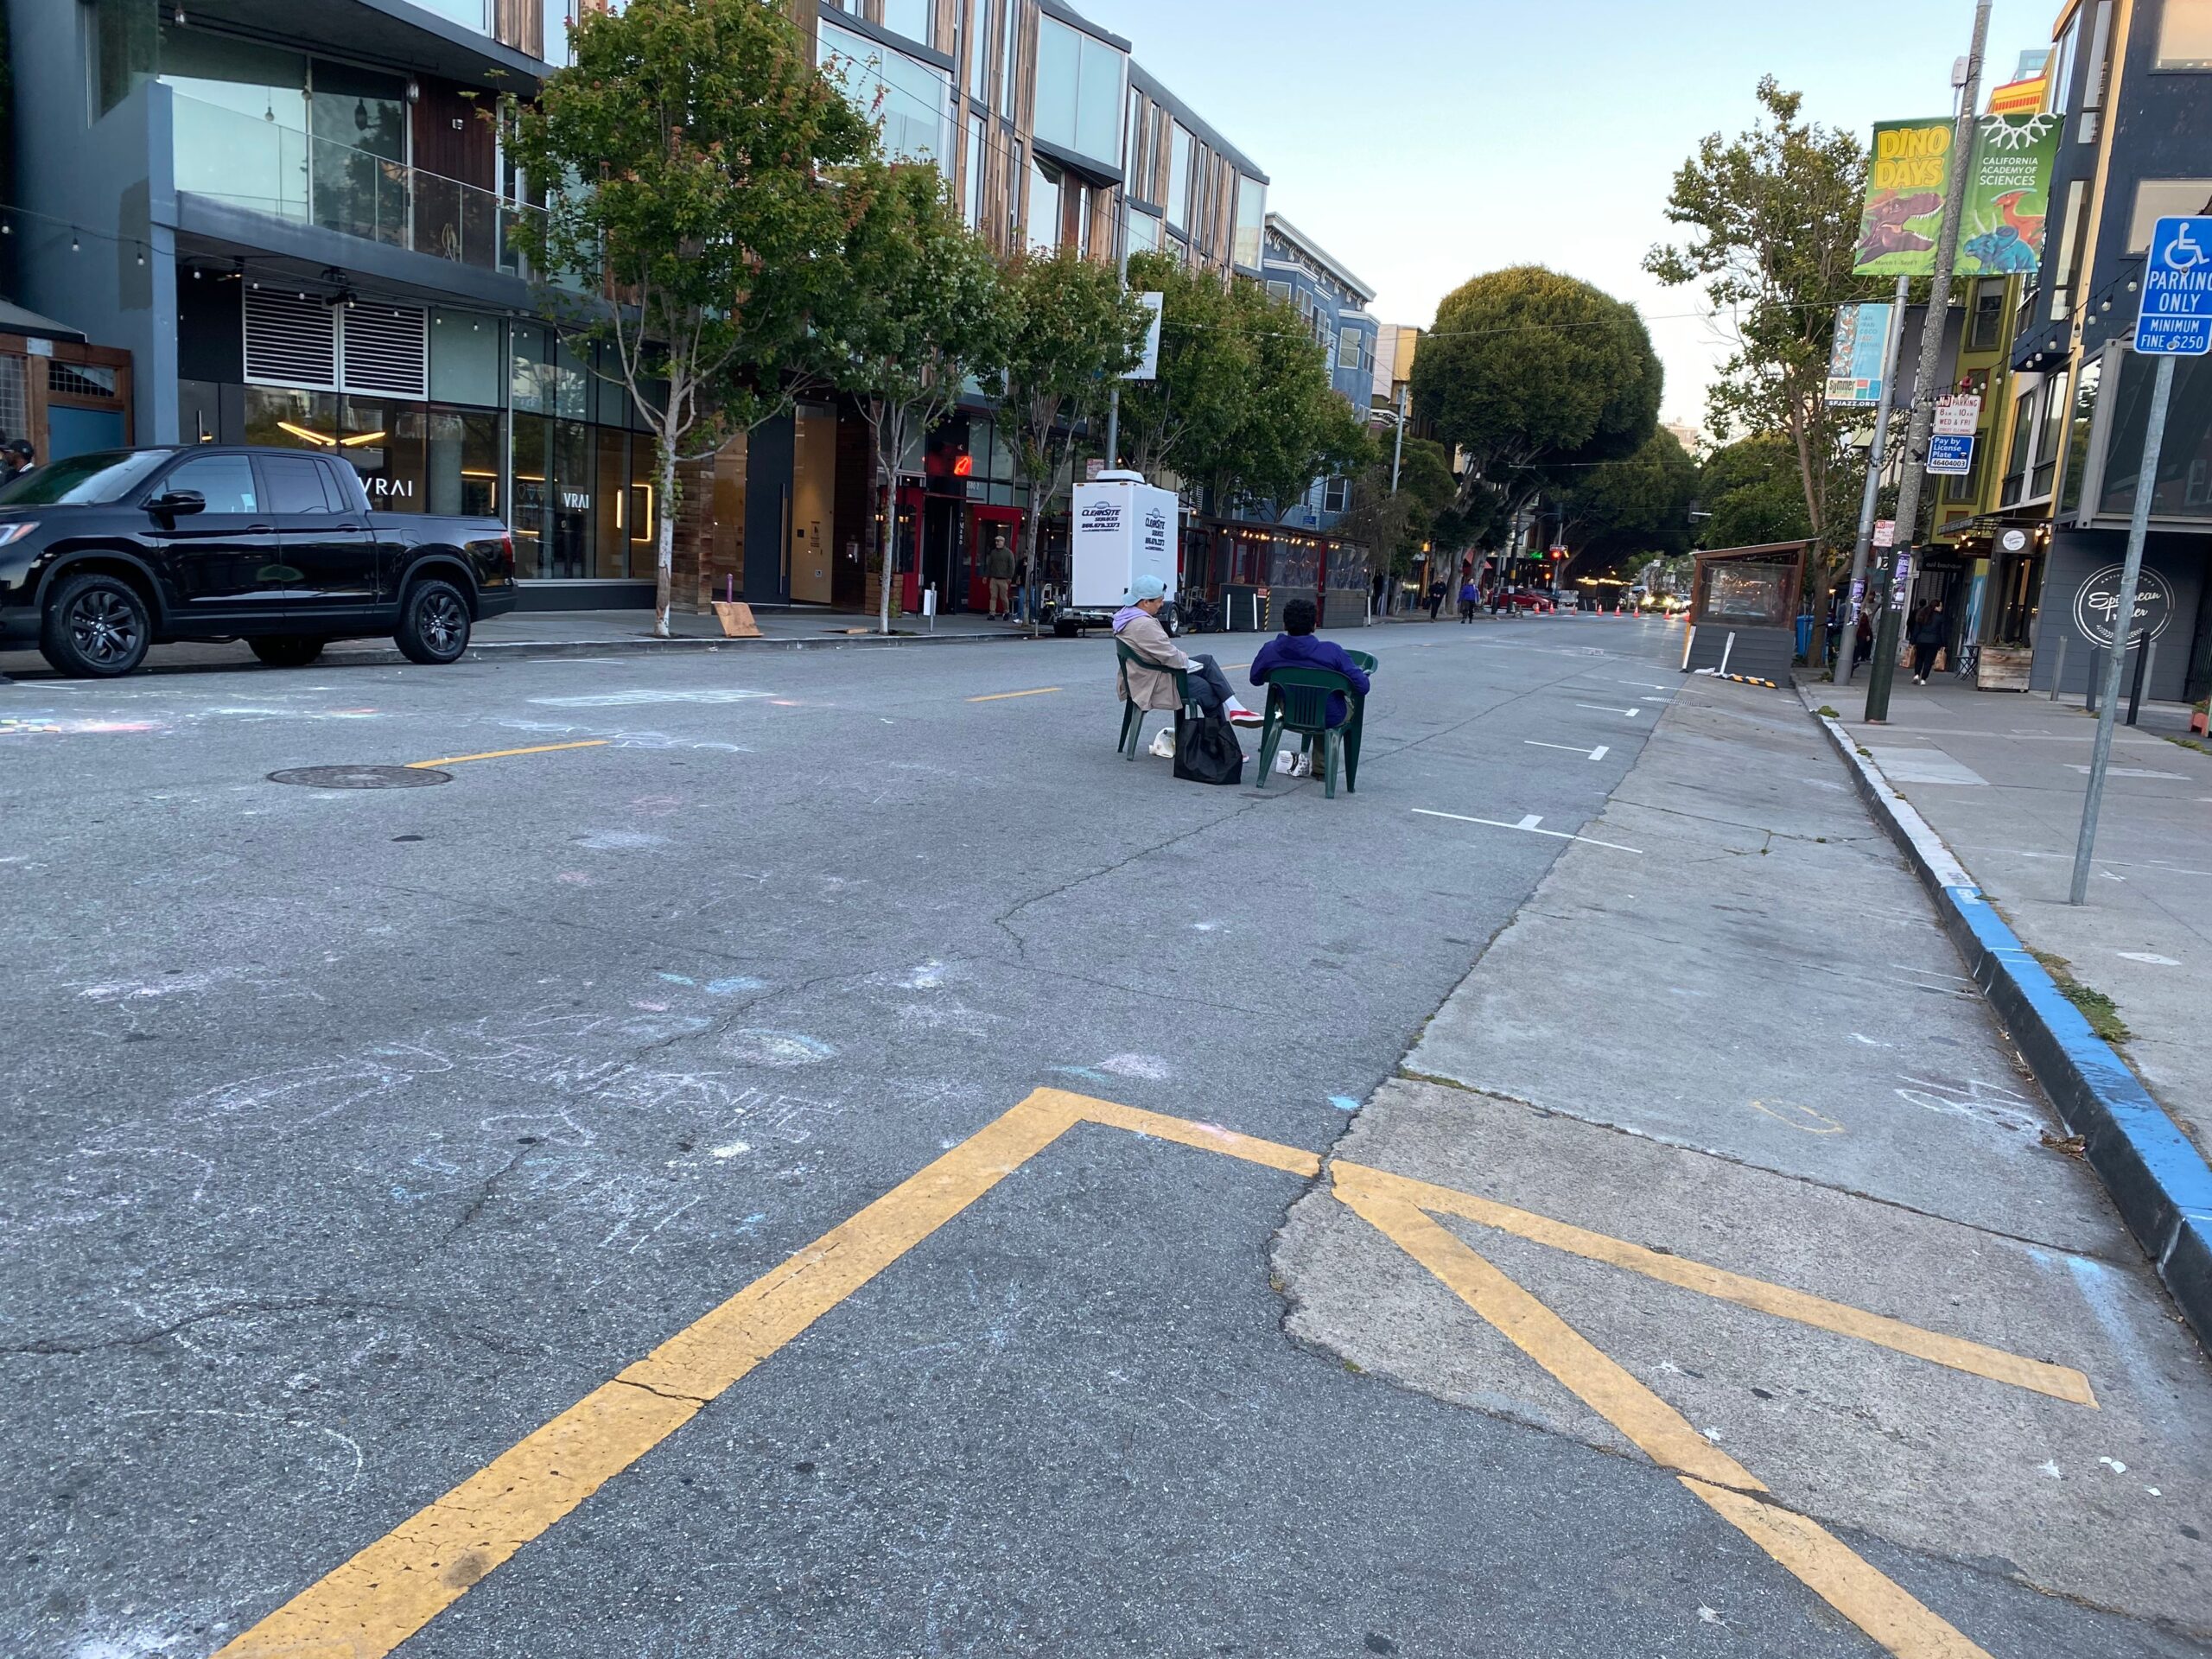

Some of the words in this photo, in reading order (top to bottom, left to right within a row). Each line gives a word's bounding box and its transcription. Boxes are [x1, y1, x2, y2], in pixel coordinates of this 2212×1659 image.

[1878, 126, 1951, 160] DINO
[1982, 156, 2038, 166] CALIFORNIA
[1874, 158, 1944, 189] DAYS
[1979, 175, 2036, 186] SCIENCES
[2158, 292, 2201, 312] ONLY
[2150, 318, 2200, 333] MINIMUM
[2140, 334, 2166, 348] FINE
[2172, 334, 2204, 349] $250
[1939, 397, 1950, 406] NO
[1952, 398, 1978, 407] PARKING
[359, 477, 412, 497] VRAI
[563, 493, 589, 509] VRAI
[2088, 591, 2162, 607] Epiean
